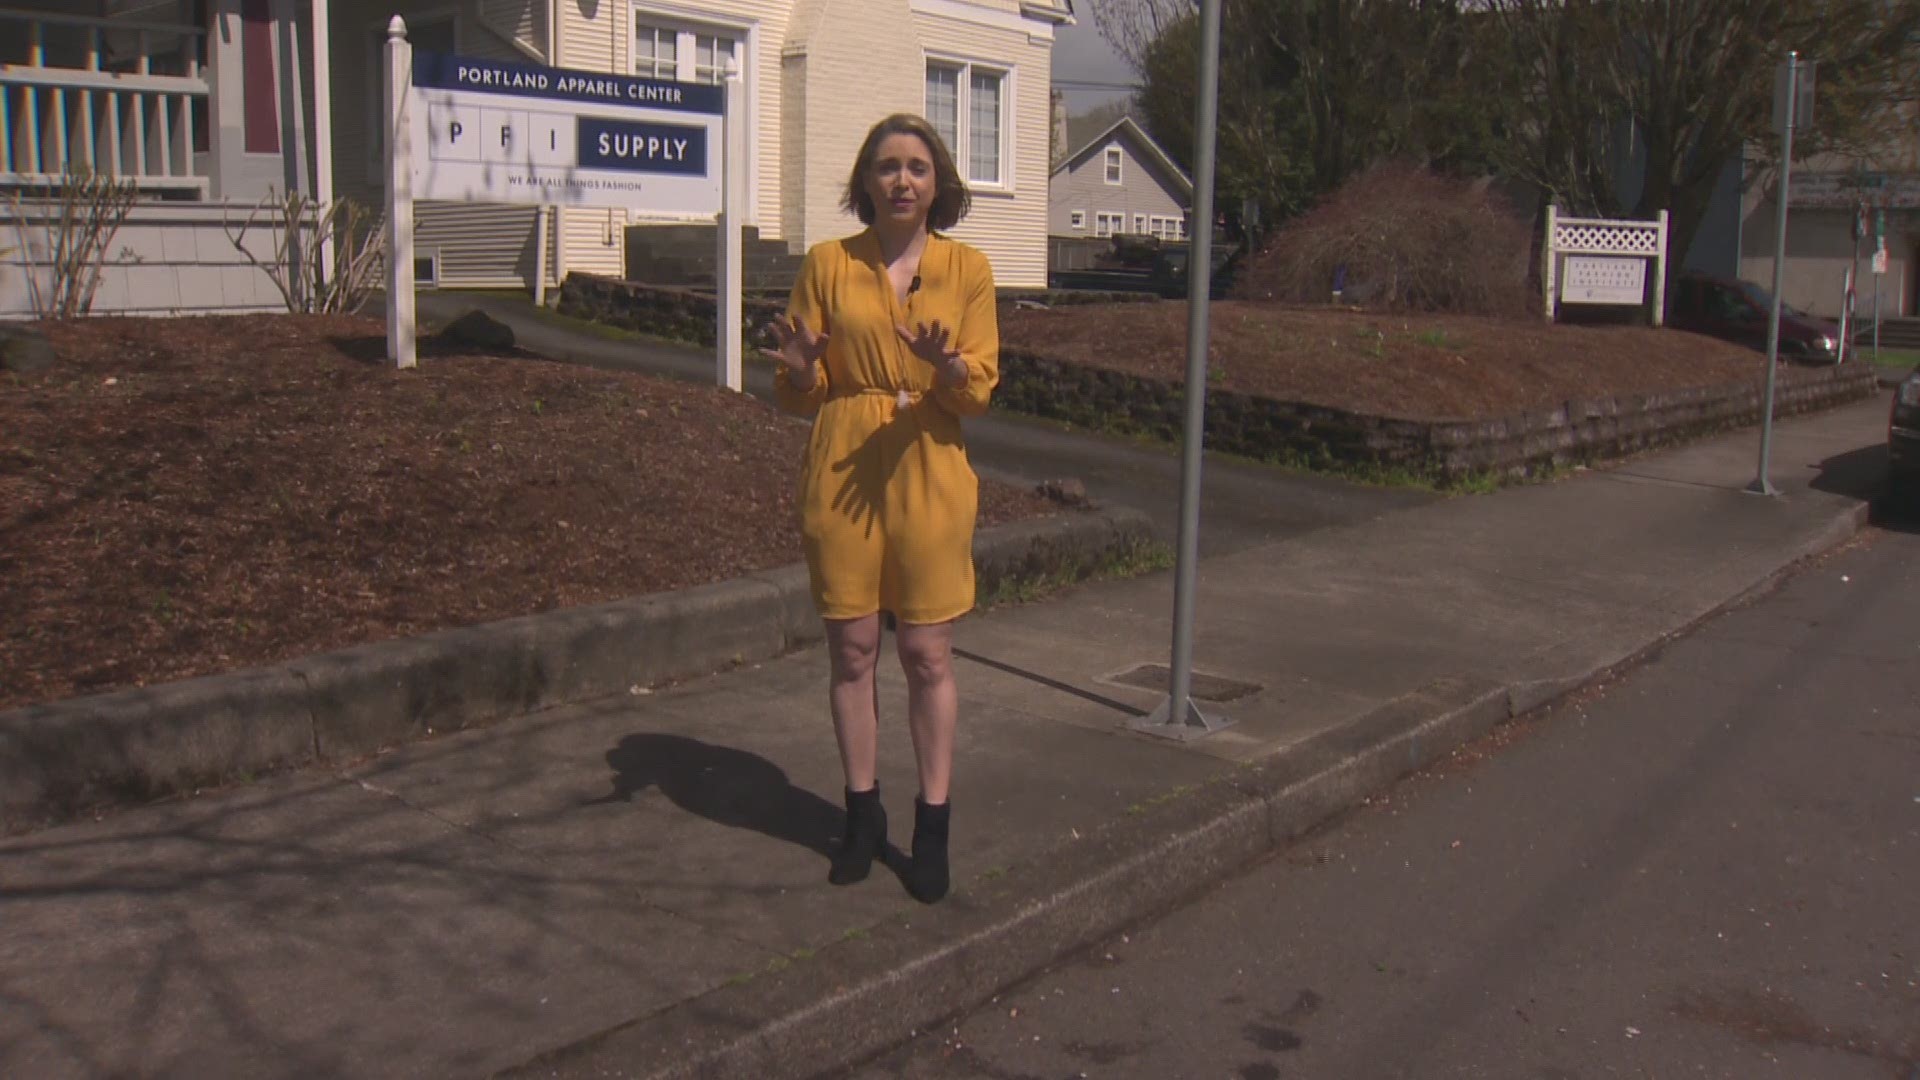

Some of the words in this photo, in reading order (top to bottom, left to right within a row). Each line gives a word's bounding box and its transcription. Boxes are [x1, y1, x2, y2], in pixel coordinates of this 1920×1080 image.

[457, 66, 548, 90] PORTLAND
[556, 77, 621, 98] APPAREL
[627, 83, 682, 103] CENTER
[598, 131, 688, 161] SUPPLY
[508, 175, 523, 185] WE
[526, 176, 543, 186] ARE
[546, 177, 562, 187] ALL
[565, 178, 600, 189] THINGS
[602, 180, 642, 192] FASHION
